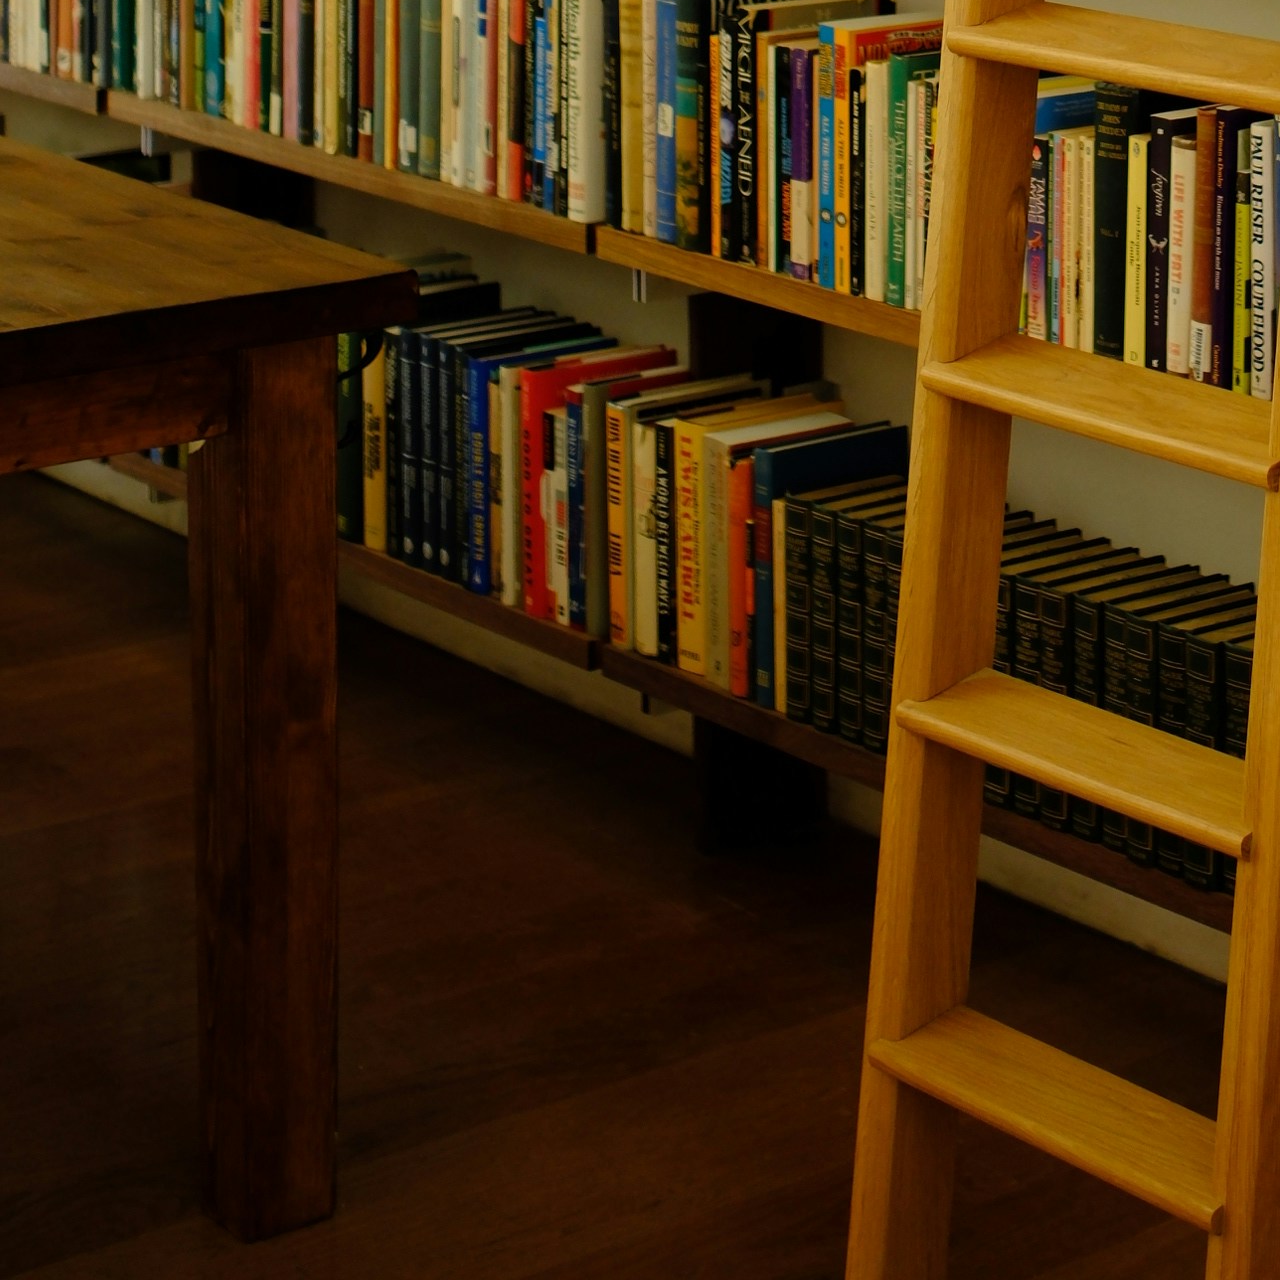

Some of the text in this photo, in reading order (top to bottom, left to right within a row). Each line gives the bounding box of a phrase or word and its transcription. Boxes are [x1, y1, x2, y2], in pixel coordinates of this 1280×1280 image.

[1251, 134, 1264, 245] PAUL REISER
[1251, 259, 1265, 373] COUPLEHOOD
